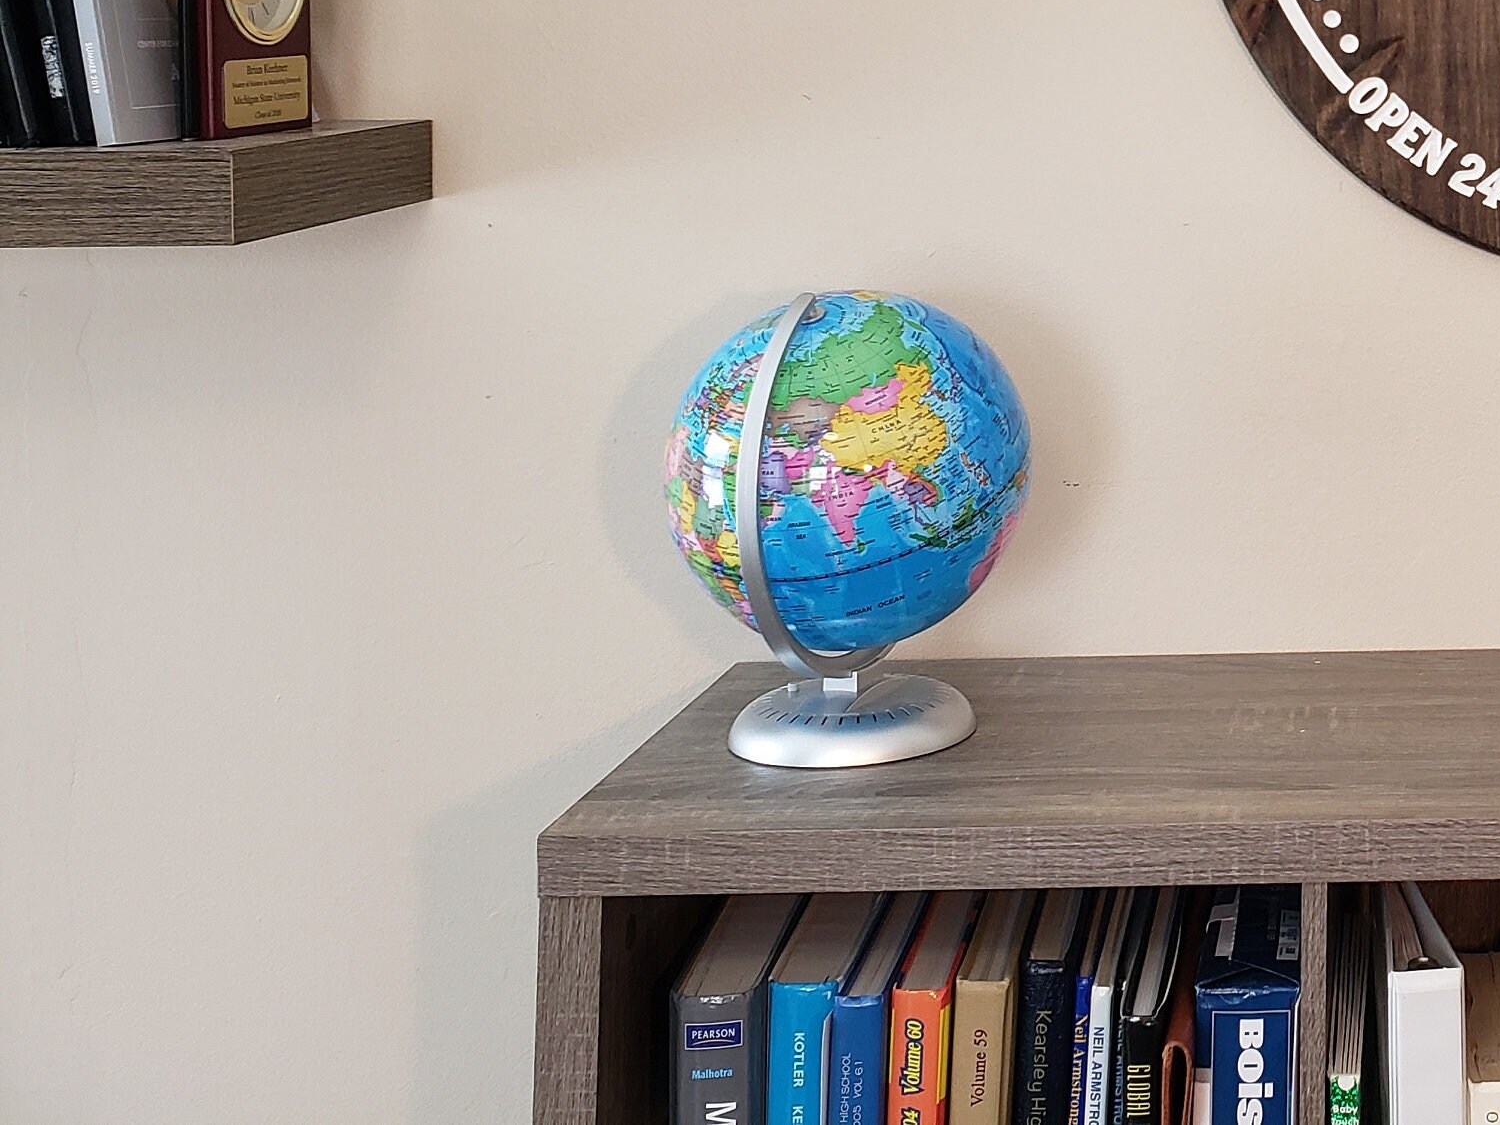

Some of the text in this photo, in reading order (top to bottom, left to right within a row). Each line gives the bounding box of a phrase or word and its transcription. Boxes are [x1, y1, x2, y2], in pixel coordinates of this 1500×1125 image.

[1348, 77, 1458, 175] OPEN
[871, 419, 902, 434] CHINA
[877, 593, 906, 608] OCEAN
[691, 1027, 735, 1040] PEARSON
[906, 1020, 922, 1039] 60
[1093, 1027, 1104, 1057] NEIL
[793, 1032, 805, 1088] KOTLER
[1027, 1010, 1052, 1092] Kearsley
[691, 1068, 733, 1080] Malhotra
[854, 1061, 863, 1075] 61
[900, 1041, 921, 1094] Volume
[970, 1030, 988, 1106] Volume 59
[1068, 1014, 1088, 1125] Neil Armstrong
[840, 1053, 851, 1123] HIGH SCHOOL
[853, 1078, 862, 1098] VOL
[1127, 1064, 1150, 1118] GLOBAL
[1331, 1104, 1358, 1115] Baby
